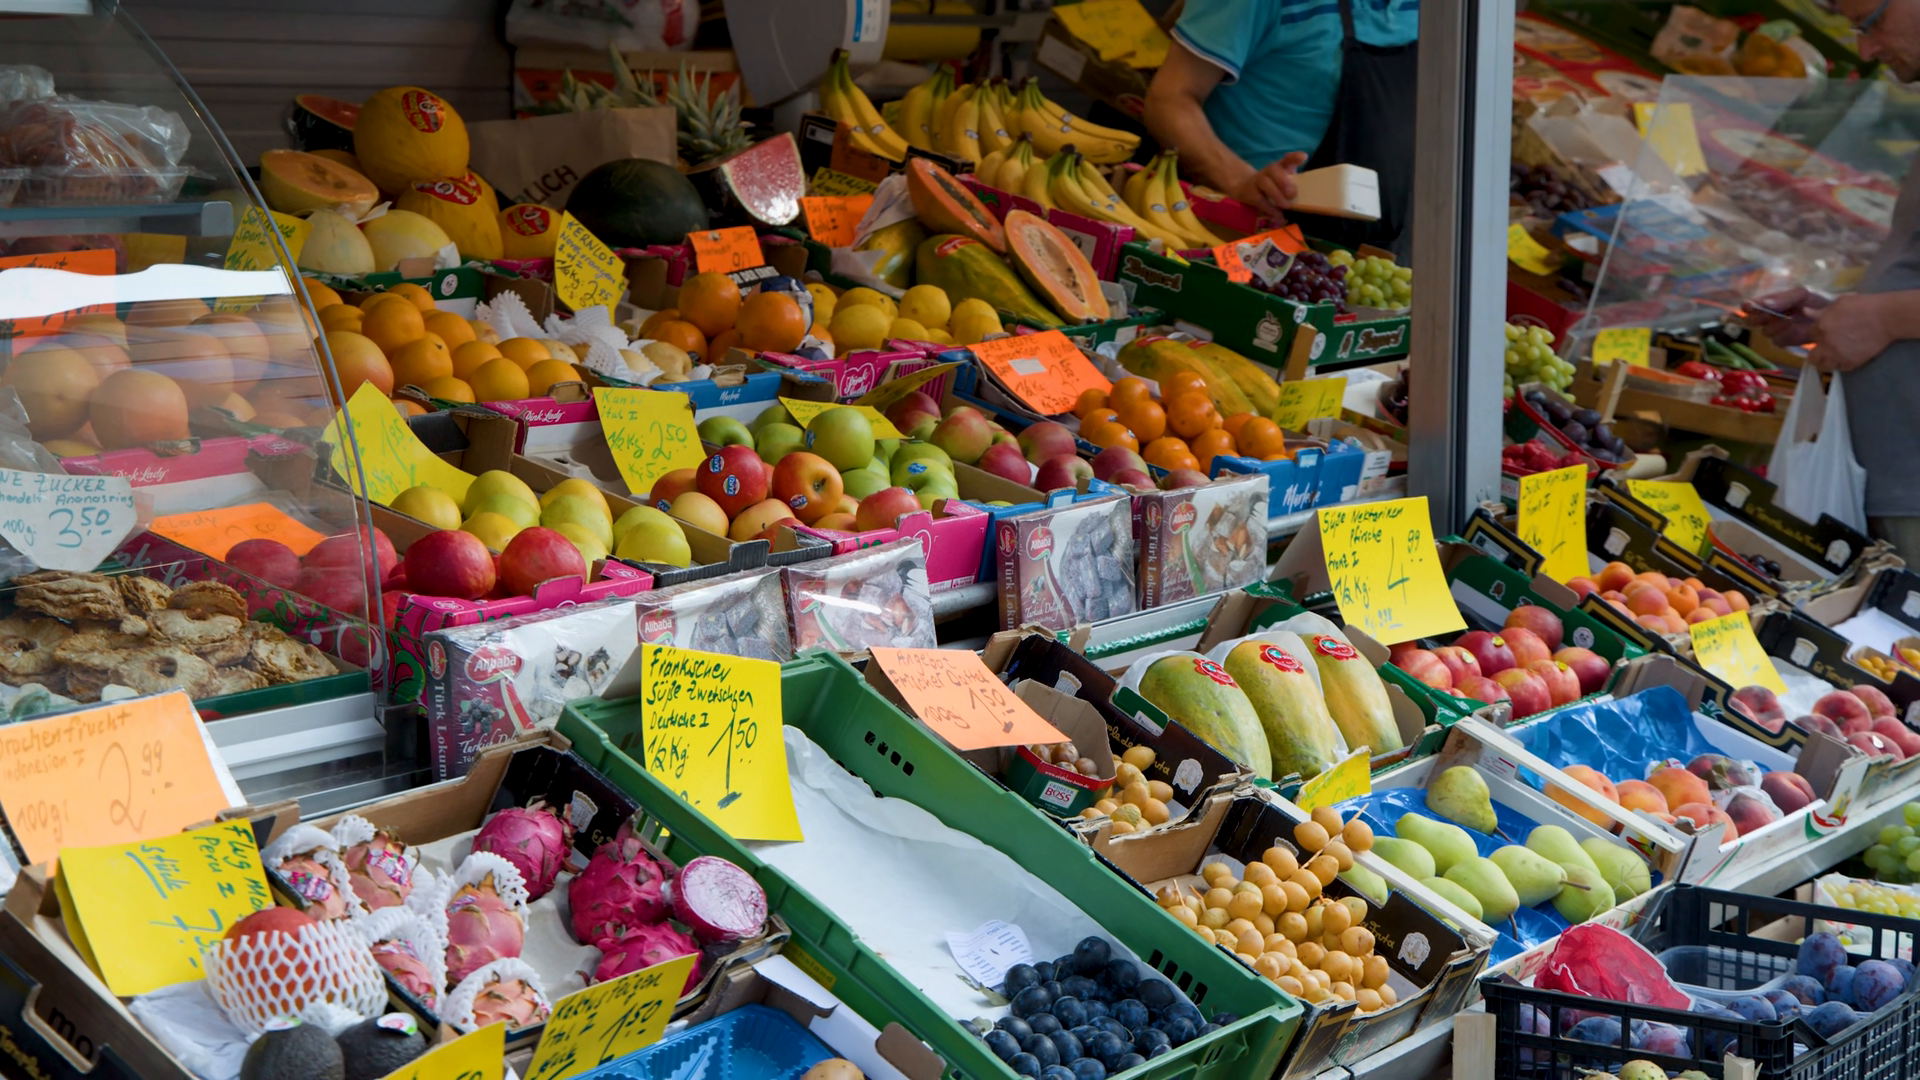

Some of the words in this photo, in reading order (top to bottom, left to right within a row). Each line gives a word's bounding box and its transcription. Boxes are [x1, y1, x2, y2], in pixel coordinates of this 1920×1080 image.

[34, 474, 105, 493] ZUCKER
[138, 467, 167, 483] Lady
[1030, 536, 1052, 551] Alibaba
[1148, 534, 1159, 562] Türk
[1004, 558, 1015, 590] Türk
[643, 619, 673, 634] Alibaba
[896, 650, 957, 676] Angebot
[434, 682, 447, 720] Türk
[646, 679, 683, 712] Süße
[1044, 786, 1072, 803] BOSS
[1048, 782, 1075, 796] ERDBEER
[193, 836, 223, 873] Peru
